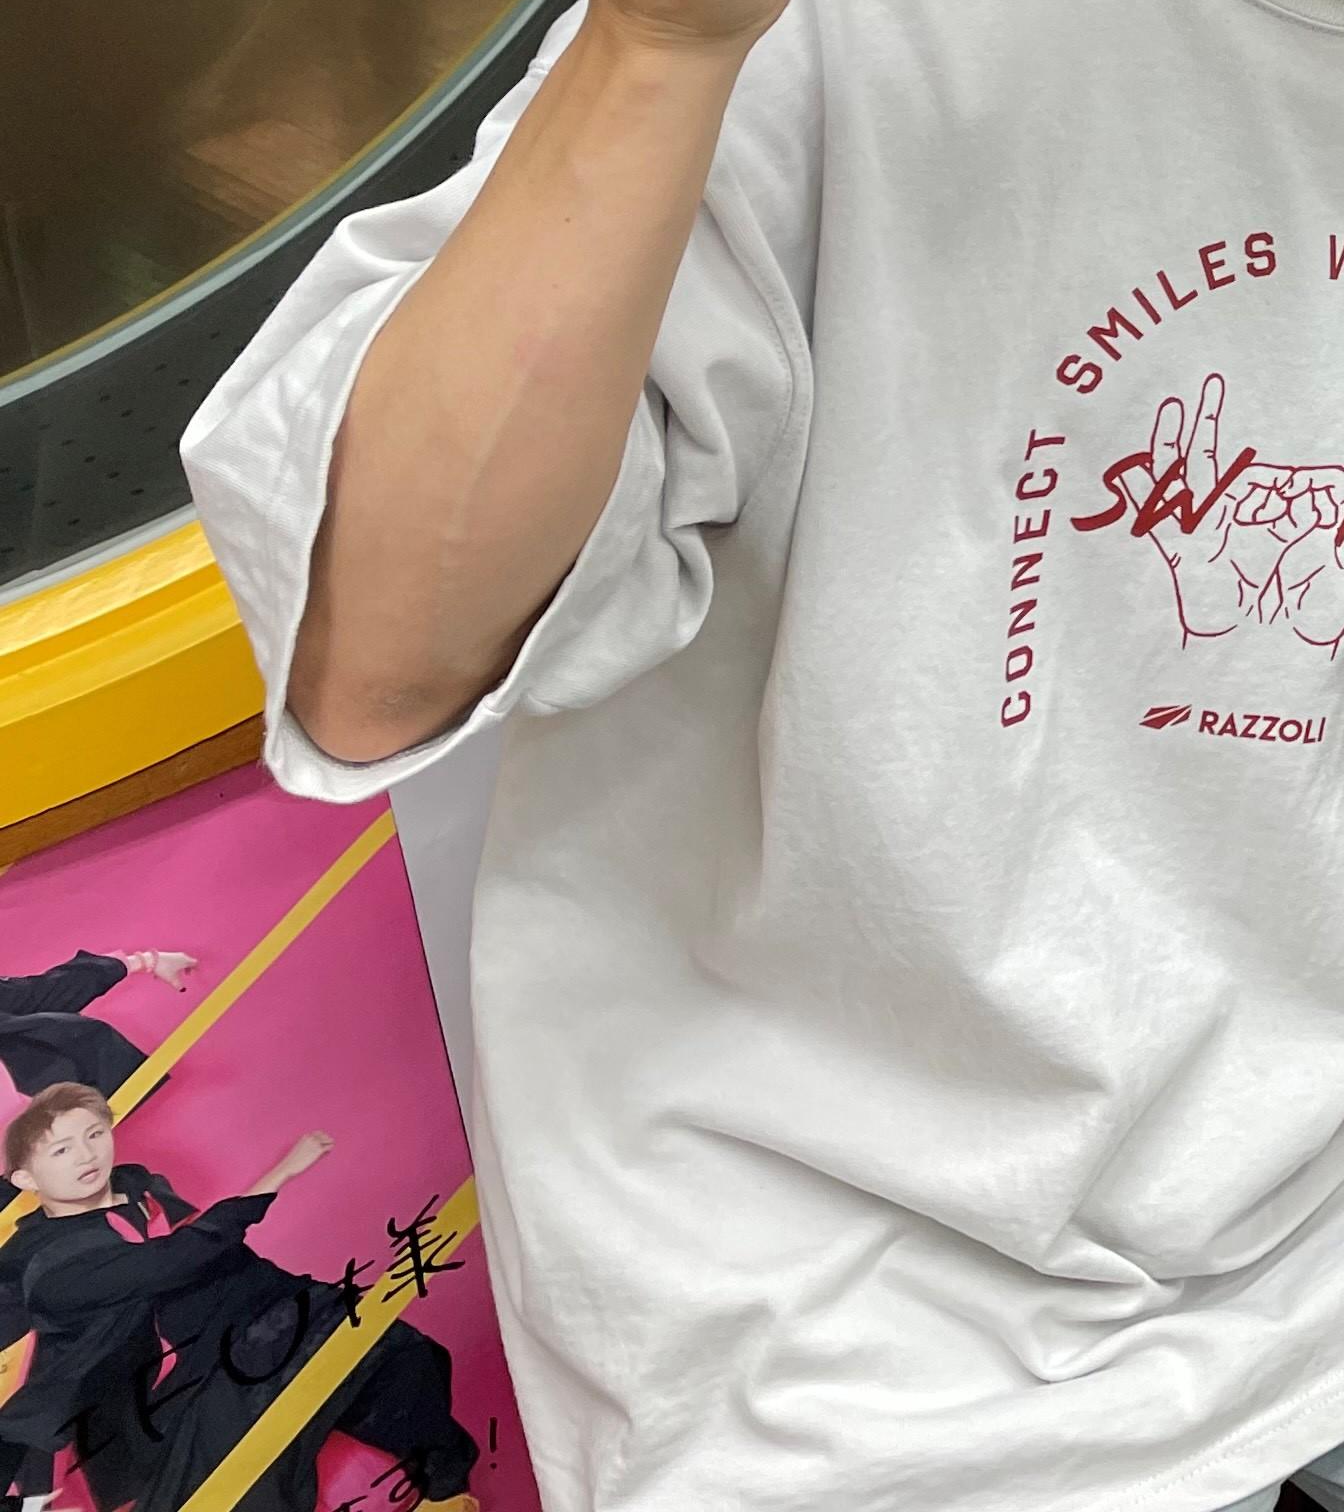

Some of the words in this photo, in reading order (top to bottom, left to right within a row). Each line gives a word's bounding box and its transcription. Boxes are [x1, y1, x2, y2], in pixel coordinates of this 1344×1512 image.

[1000, 428, 1066, 728] CONNECT
[1056, 231, 1277, 395] SMILES
[1197, 708, 1328, 745] RAZZOLI
